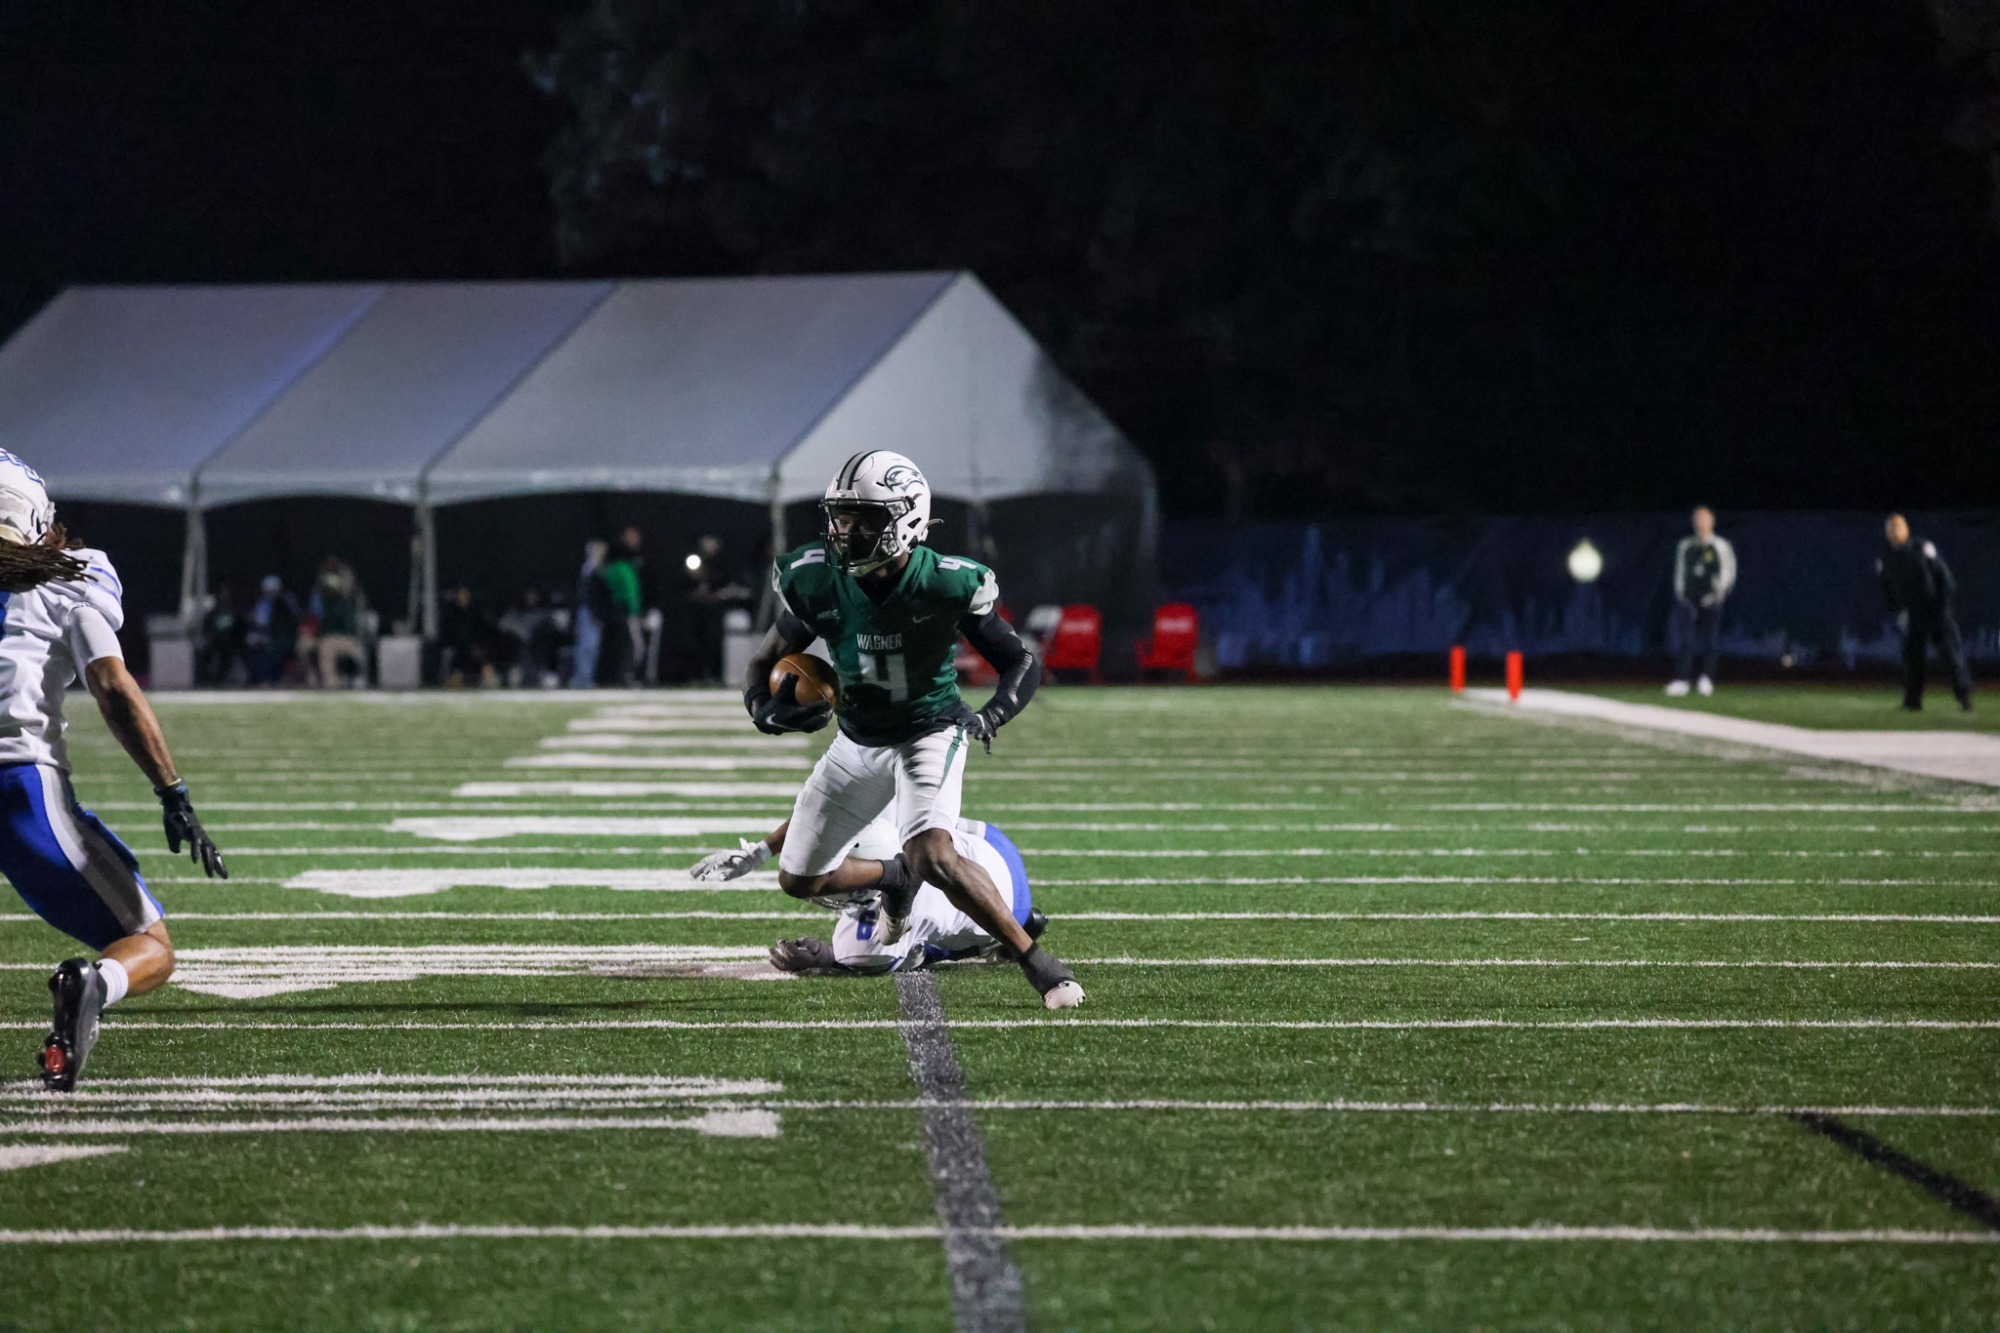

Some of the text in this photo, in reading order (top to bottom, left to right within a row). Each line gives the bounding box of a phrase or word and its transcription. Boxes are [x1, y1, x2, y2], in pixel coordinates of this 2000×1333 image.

[938, 557, 978, 570] 4
[856, 633, 903, 650] WAGNER
[858, 652, 908, 701] 4
